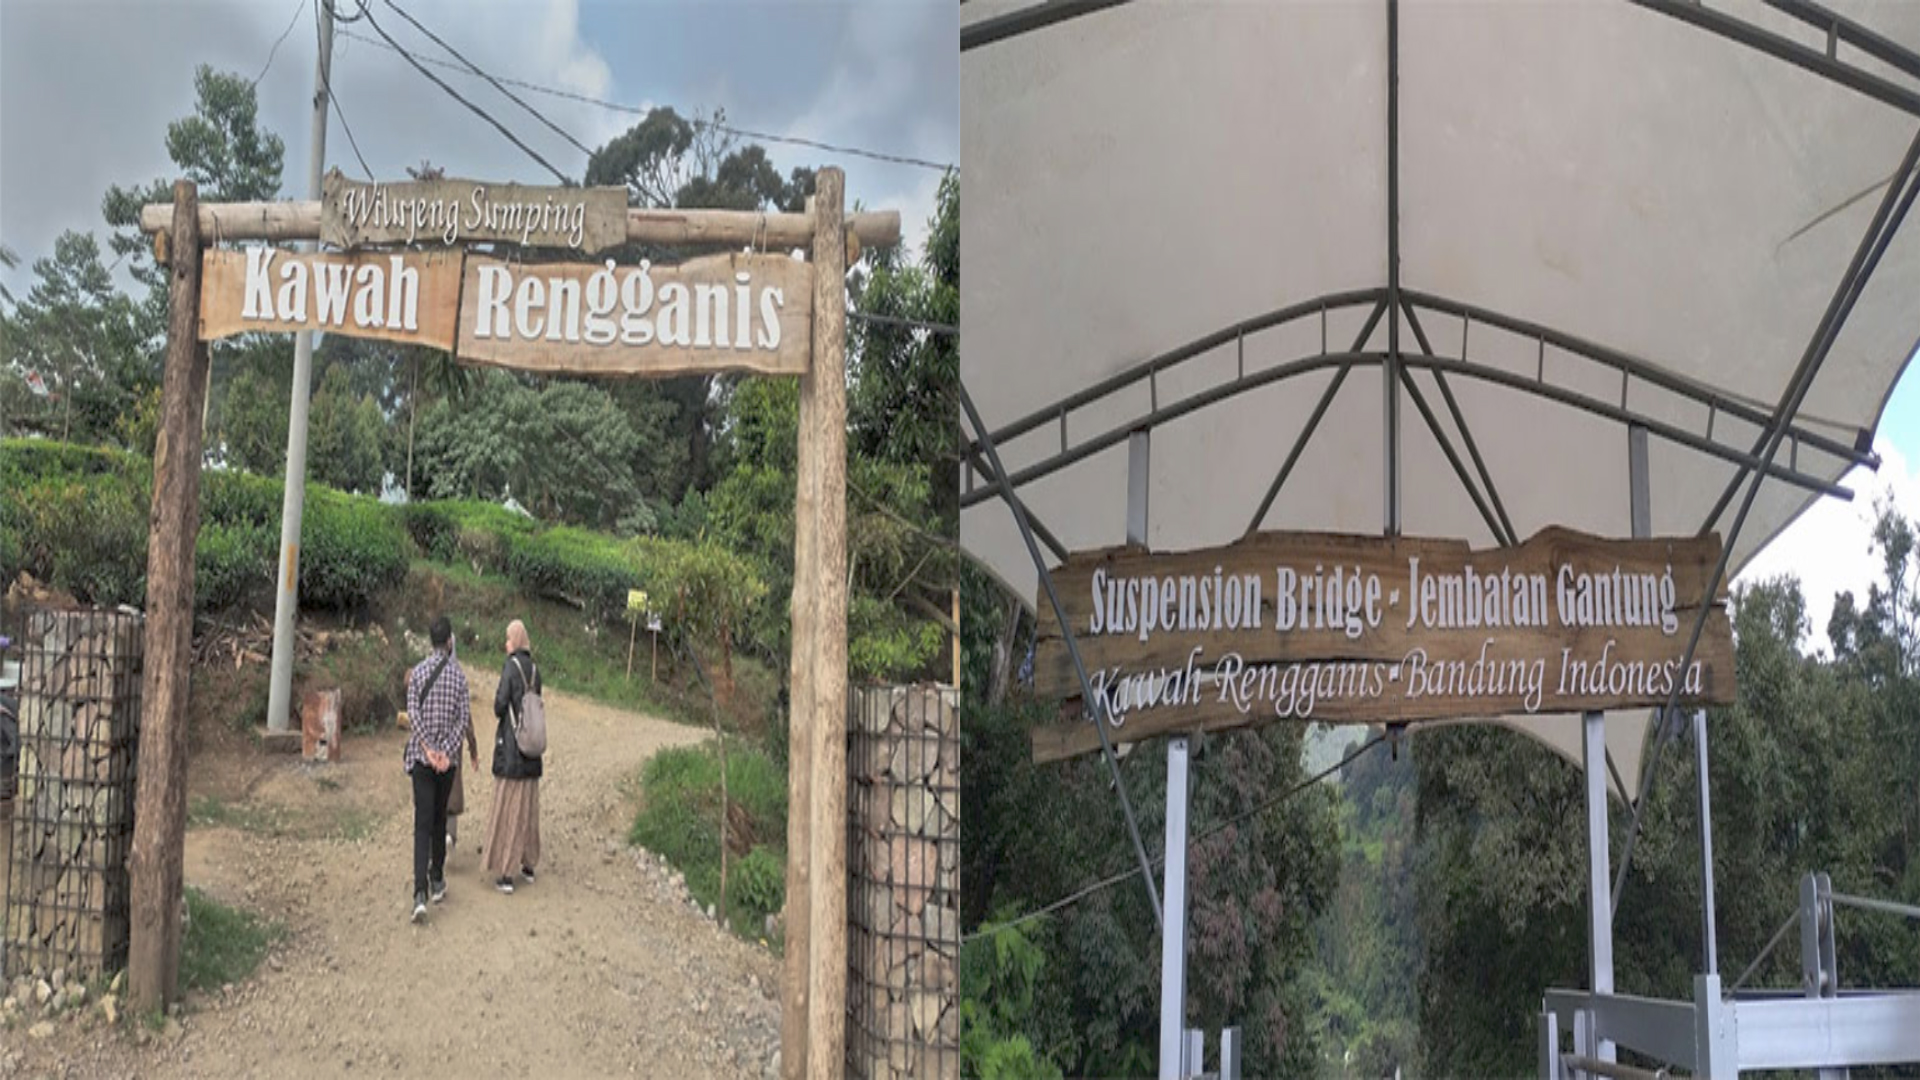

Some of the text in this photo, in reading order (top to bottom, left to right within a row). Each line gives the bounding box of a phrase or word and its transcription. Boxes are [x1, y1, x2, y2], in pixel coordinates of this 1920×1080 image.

[343, 180, 586, 248] Wilujeng Sumping
[242, 245, 785, 350] Kawah Rengganis
[1090, 565, 1263, 641] Suspension
[1275, 564, 1383, 639] Bridge
[1406, 556, 1549, 629] Jembatan
[1556, 563, 1679, 635] Gantung
[1084, 645, 1203, 727] Kawah
[1214, 652, 1386, 718] Rengganis
[1400, 637, 1545, 712] Bandung
